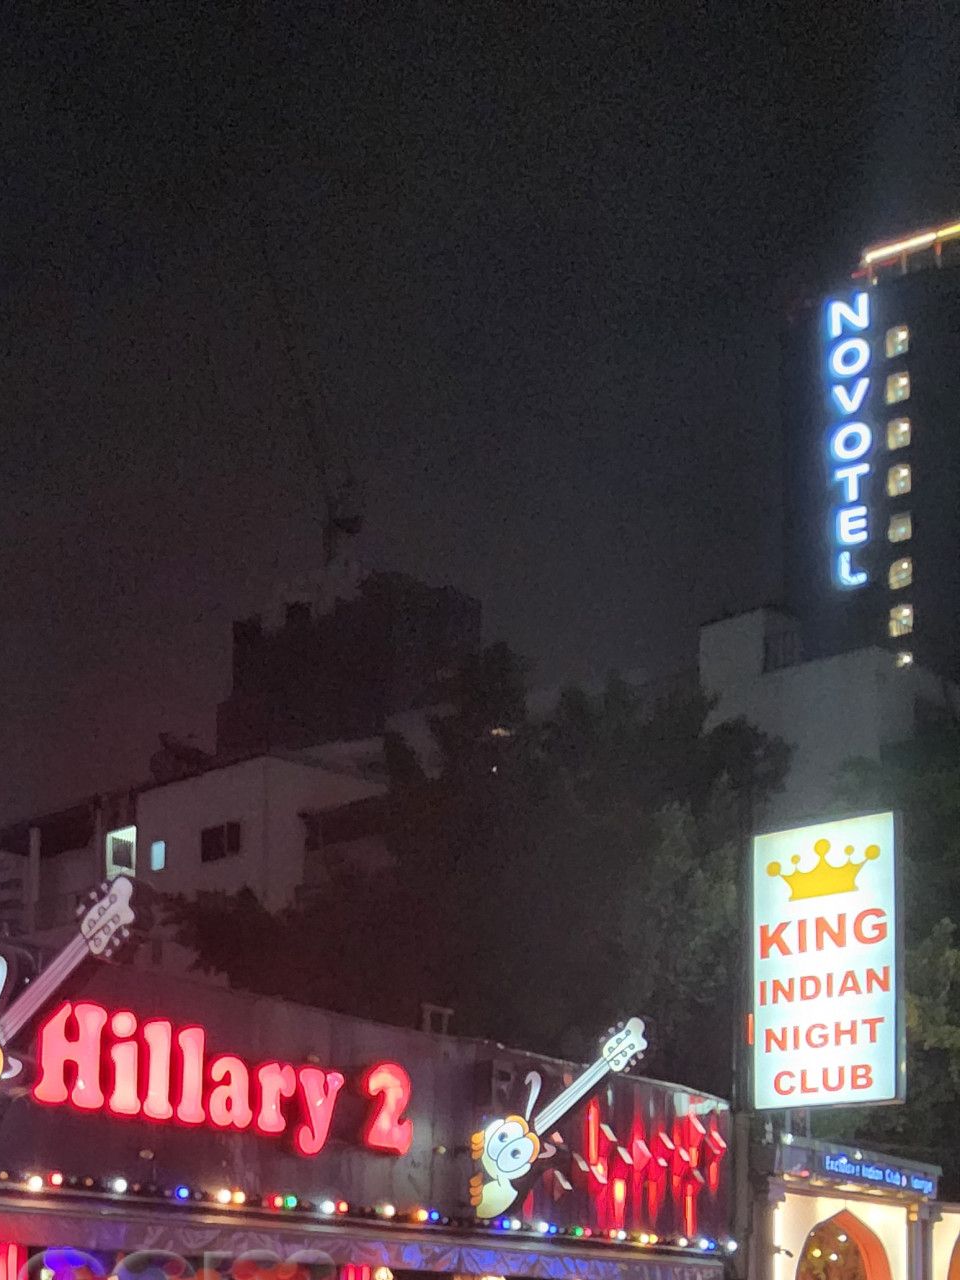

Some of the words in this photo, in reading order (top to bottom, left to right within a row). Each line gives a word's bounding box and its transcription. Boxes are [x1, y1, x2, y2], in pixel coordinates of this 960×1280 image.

[826, 292, 872, 588] NOVOTEL
[759, 907, 888, 960] KING
[759, 965, 891, 1007] INDIAN
[764, 1016, 886, 1054] NIGHT
[34, 1000, 345, 1156] Hillary
[364, 1060, 414, 1156] 2
[773, 1064, 874, 1097] CLUB
